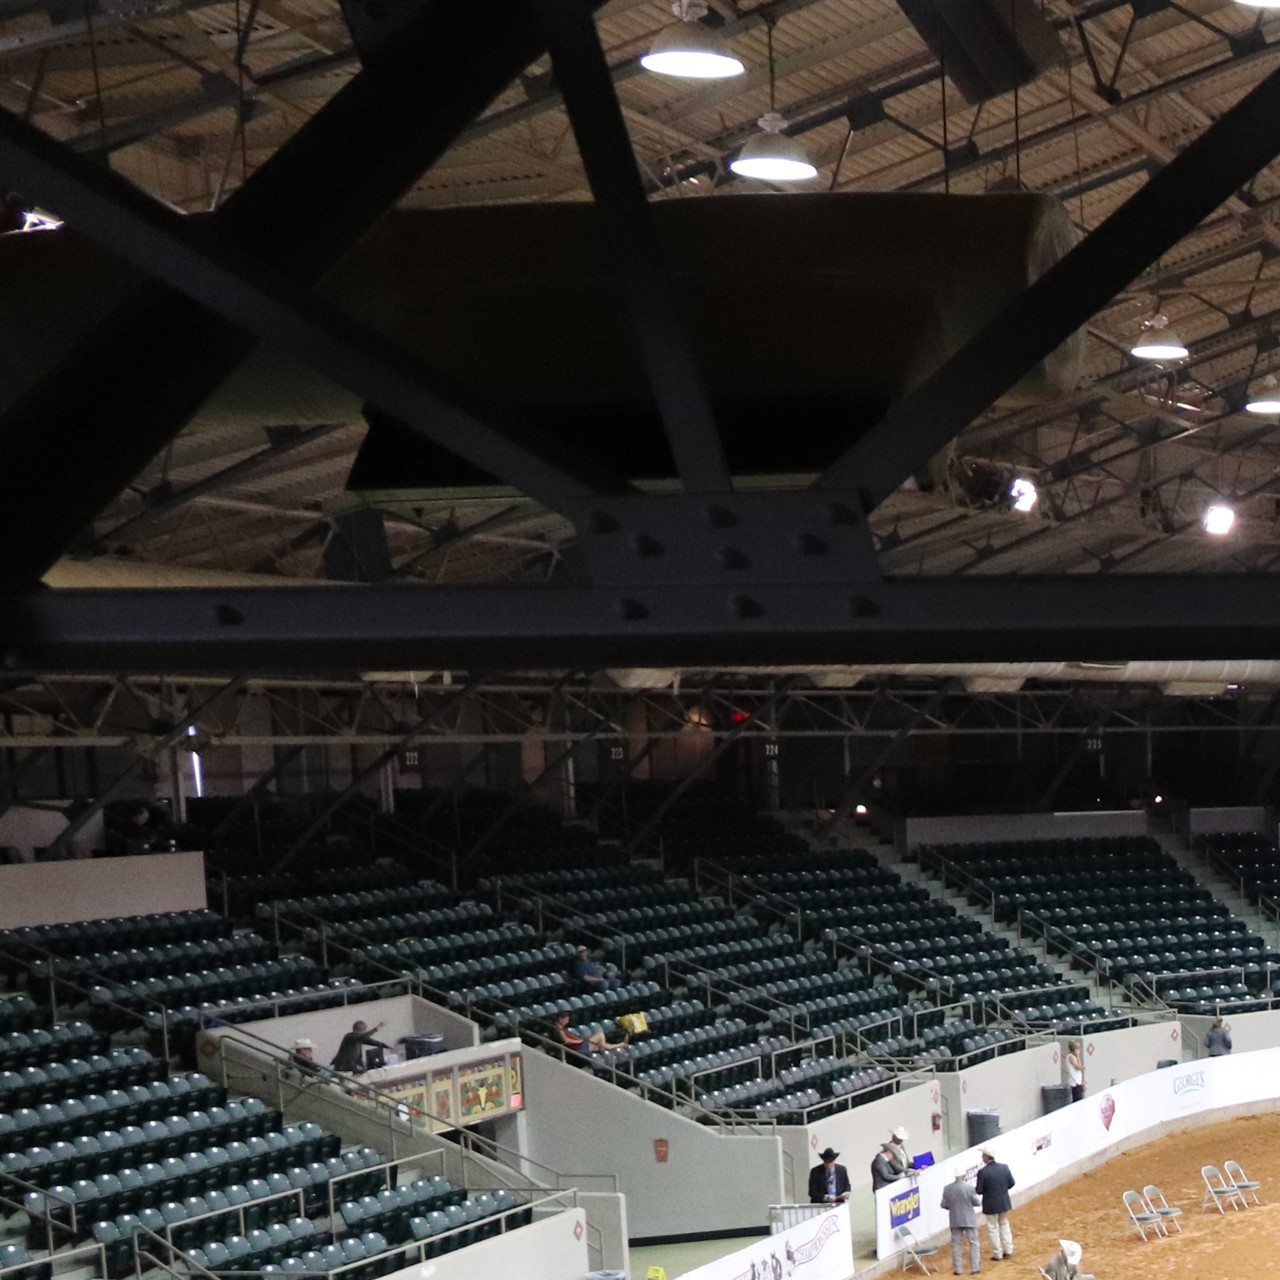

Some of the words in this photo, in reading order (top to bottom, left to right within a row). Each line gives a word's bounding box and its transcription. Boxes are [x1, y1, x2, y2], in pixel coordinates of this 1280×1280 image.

[765, 744, 779, 755] 224
[1087, 739, 1102, 749] 225
[891, 1192, 919, 1219] Wrangler
